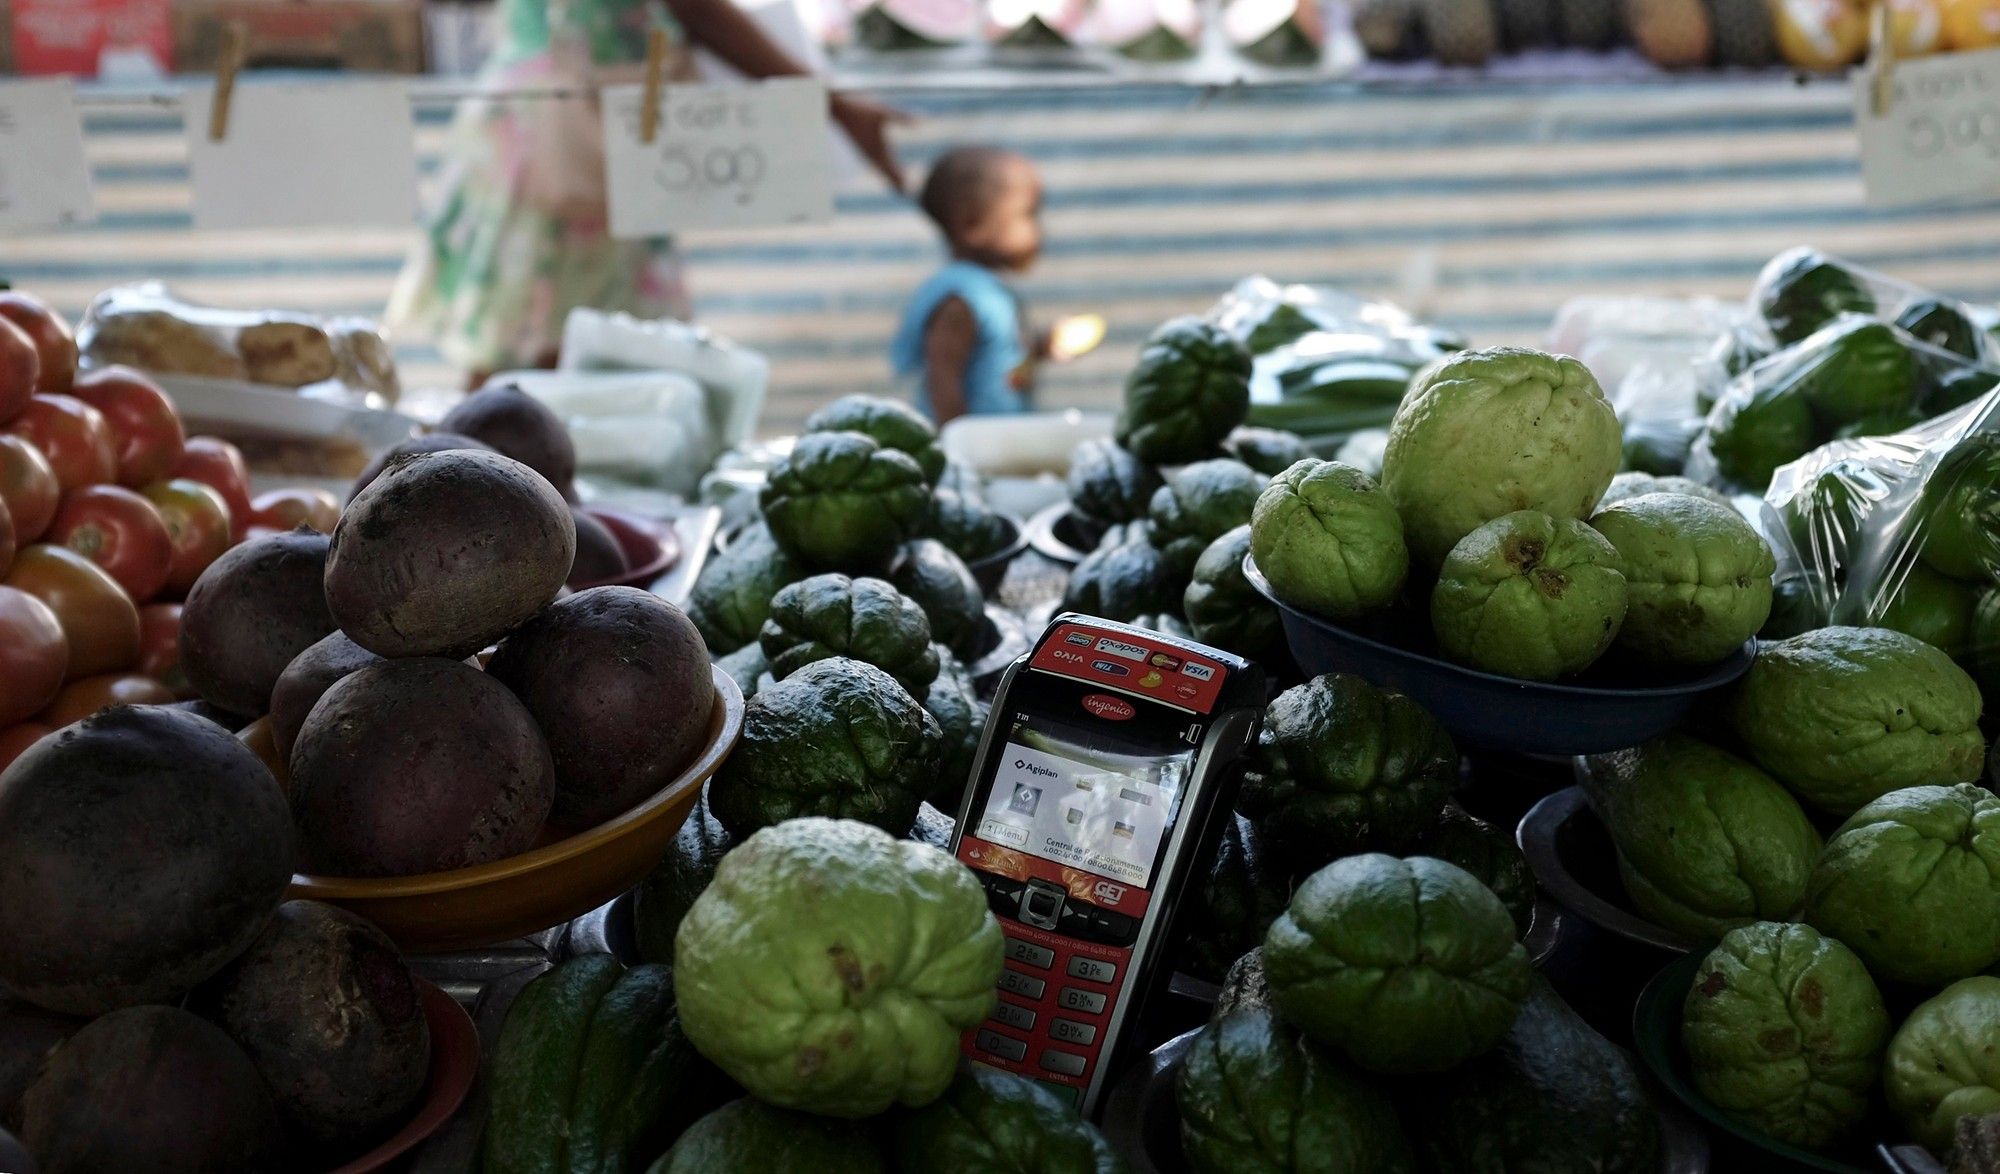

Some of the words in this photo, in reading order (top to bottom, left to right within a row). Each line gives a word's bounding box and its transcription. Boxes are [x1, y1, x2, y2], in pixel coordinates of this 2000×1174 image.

[1100, 638, 1146, 657] sodexo
[1053, 650, 1084, 664] vivo
[1094, 661, 1113, 672] TIM
[1184, 664, 1210, 678] VISA
[1086, 696, 1132, 717] ingenico
[1025, 762, 1059, 779] Agiplan
[997, 826, 1024, 842] Menu
[1045, 837, 1073, 852] Central
[1074, 845, 1083, 855] de
[982, 851, 1024, 873] Santander
[1094, 881, 1128, 902] GET
